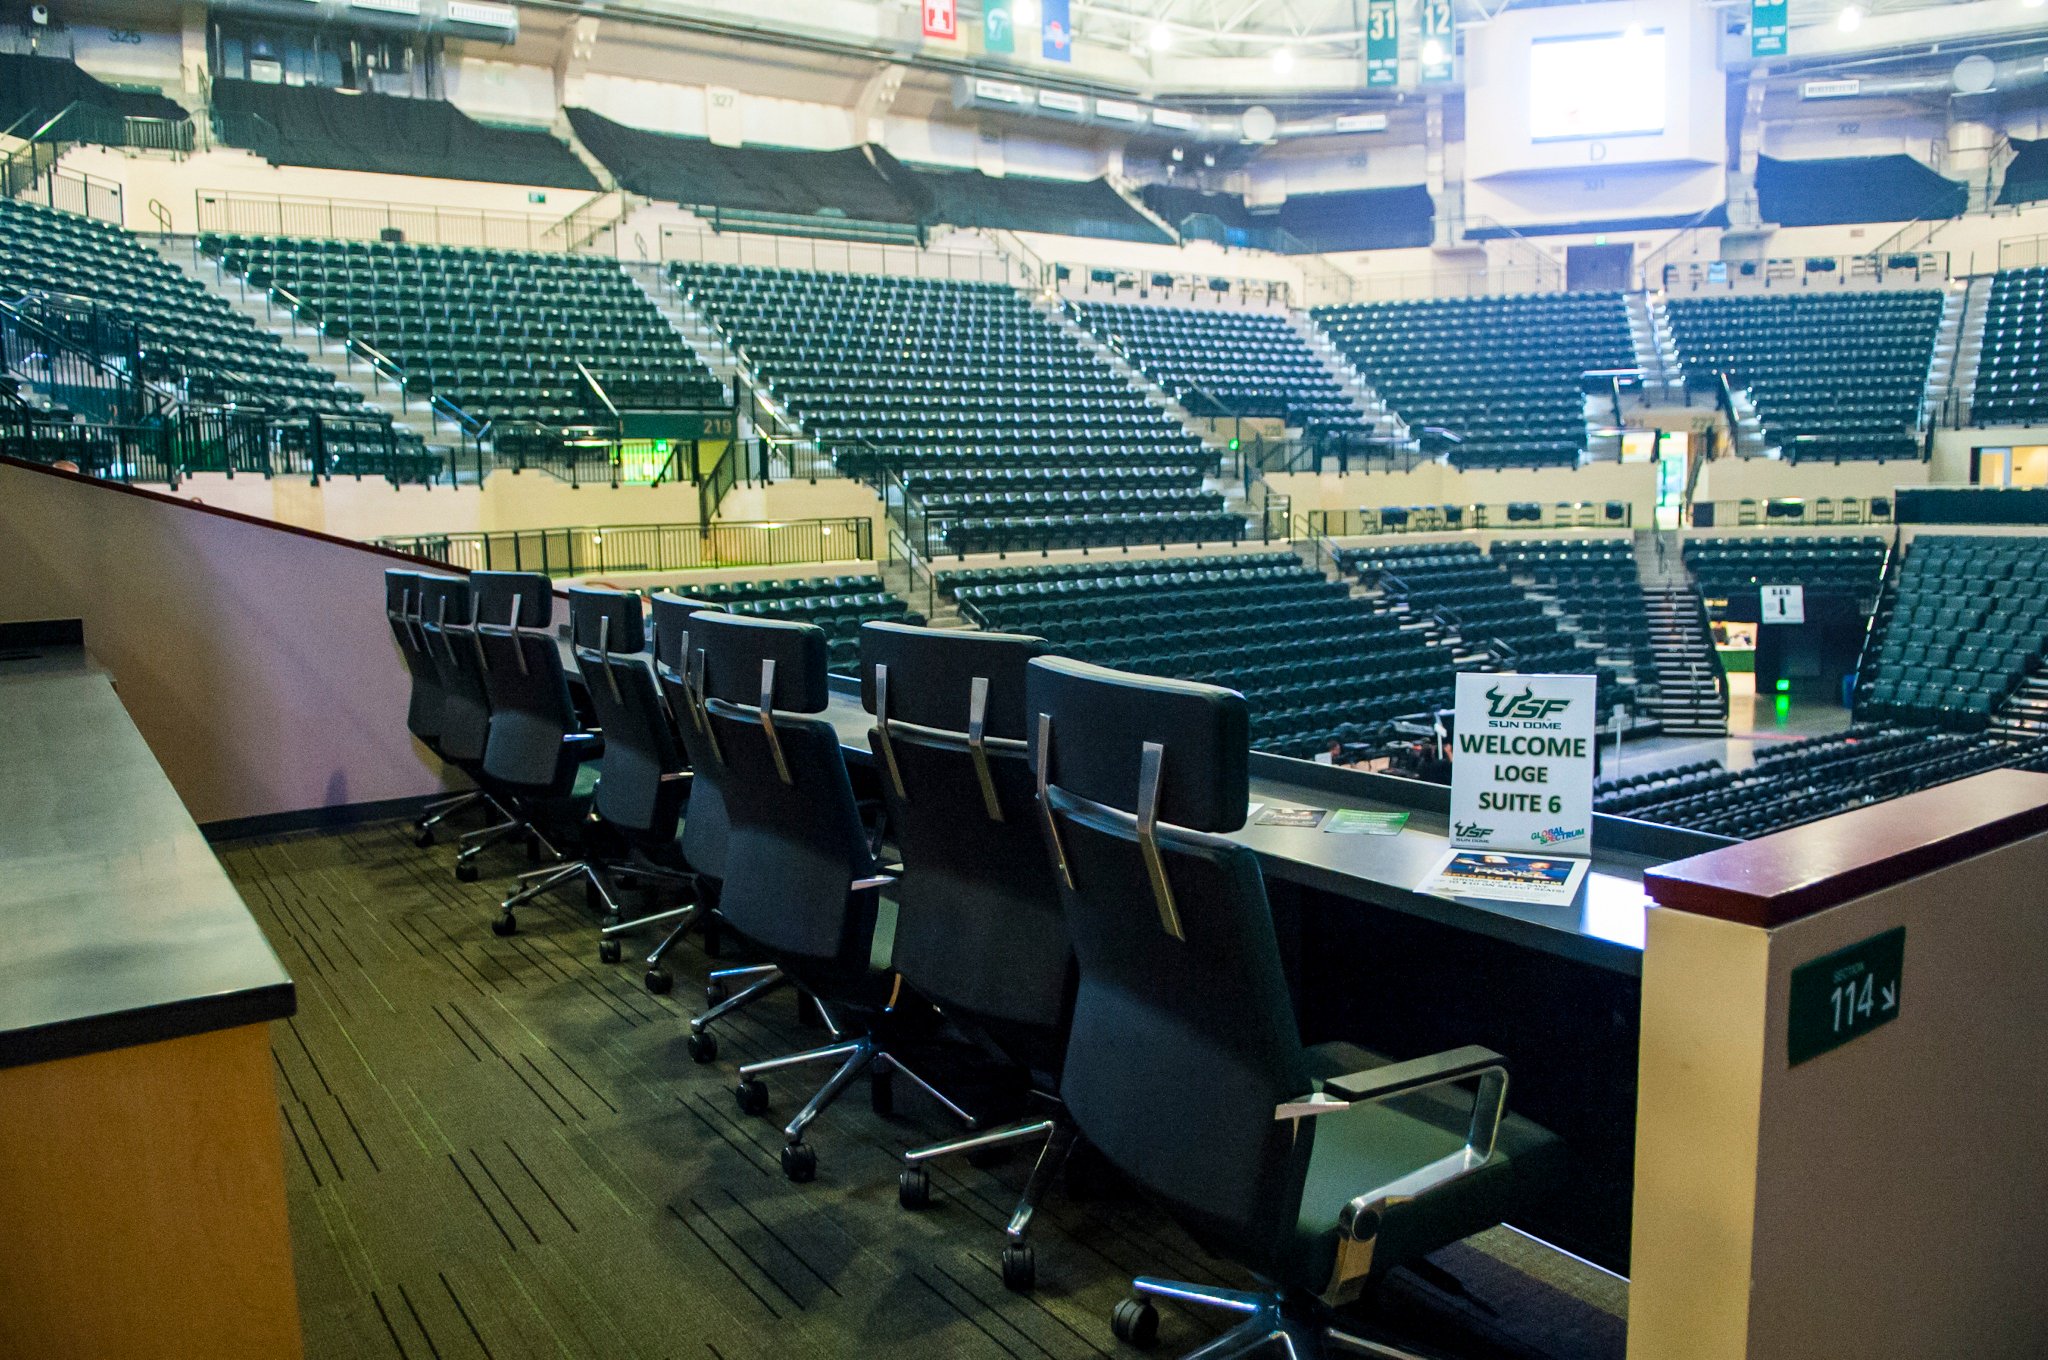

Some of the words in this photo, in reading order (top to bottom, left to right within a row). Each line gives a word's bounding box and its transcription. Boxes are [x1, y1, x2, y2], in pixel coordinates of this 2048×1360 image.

[1370, 9, 1396, 41] 31
[1424, 3, 1451, 35] 12
[107, 30, 142, 45] 325
[711, 92, 735, 108] 327
[1590, 142, 1607, 161] D
[703, 418, 733, 435] 219
[1486, 681, 1572, 719] USF
[1488, 720, 1520, 729] SUN
[1523, 721, 1562, 730] DOME
[1459, 733, 1587, 758] WELCOME
[1494, 764, 1549, 784] LOGE
[1478, 791, 1542, 813] SUITE
[1548, 795, 1561, 814] 6
[1454, 821, 1495, 838] USF
[1531, 826, 1563, 841] GLOBAL
[1539, 827, 1585, 844] SPECTRUM
[1831, 972, 1875, 1032] 114
